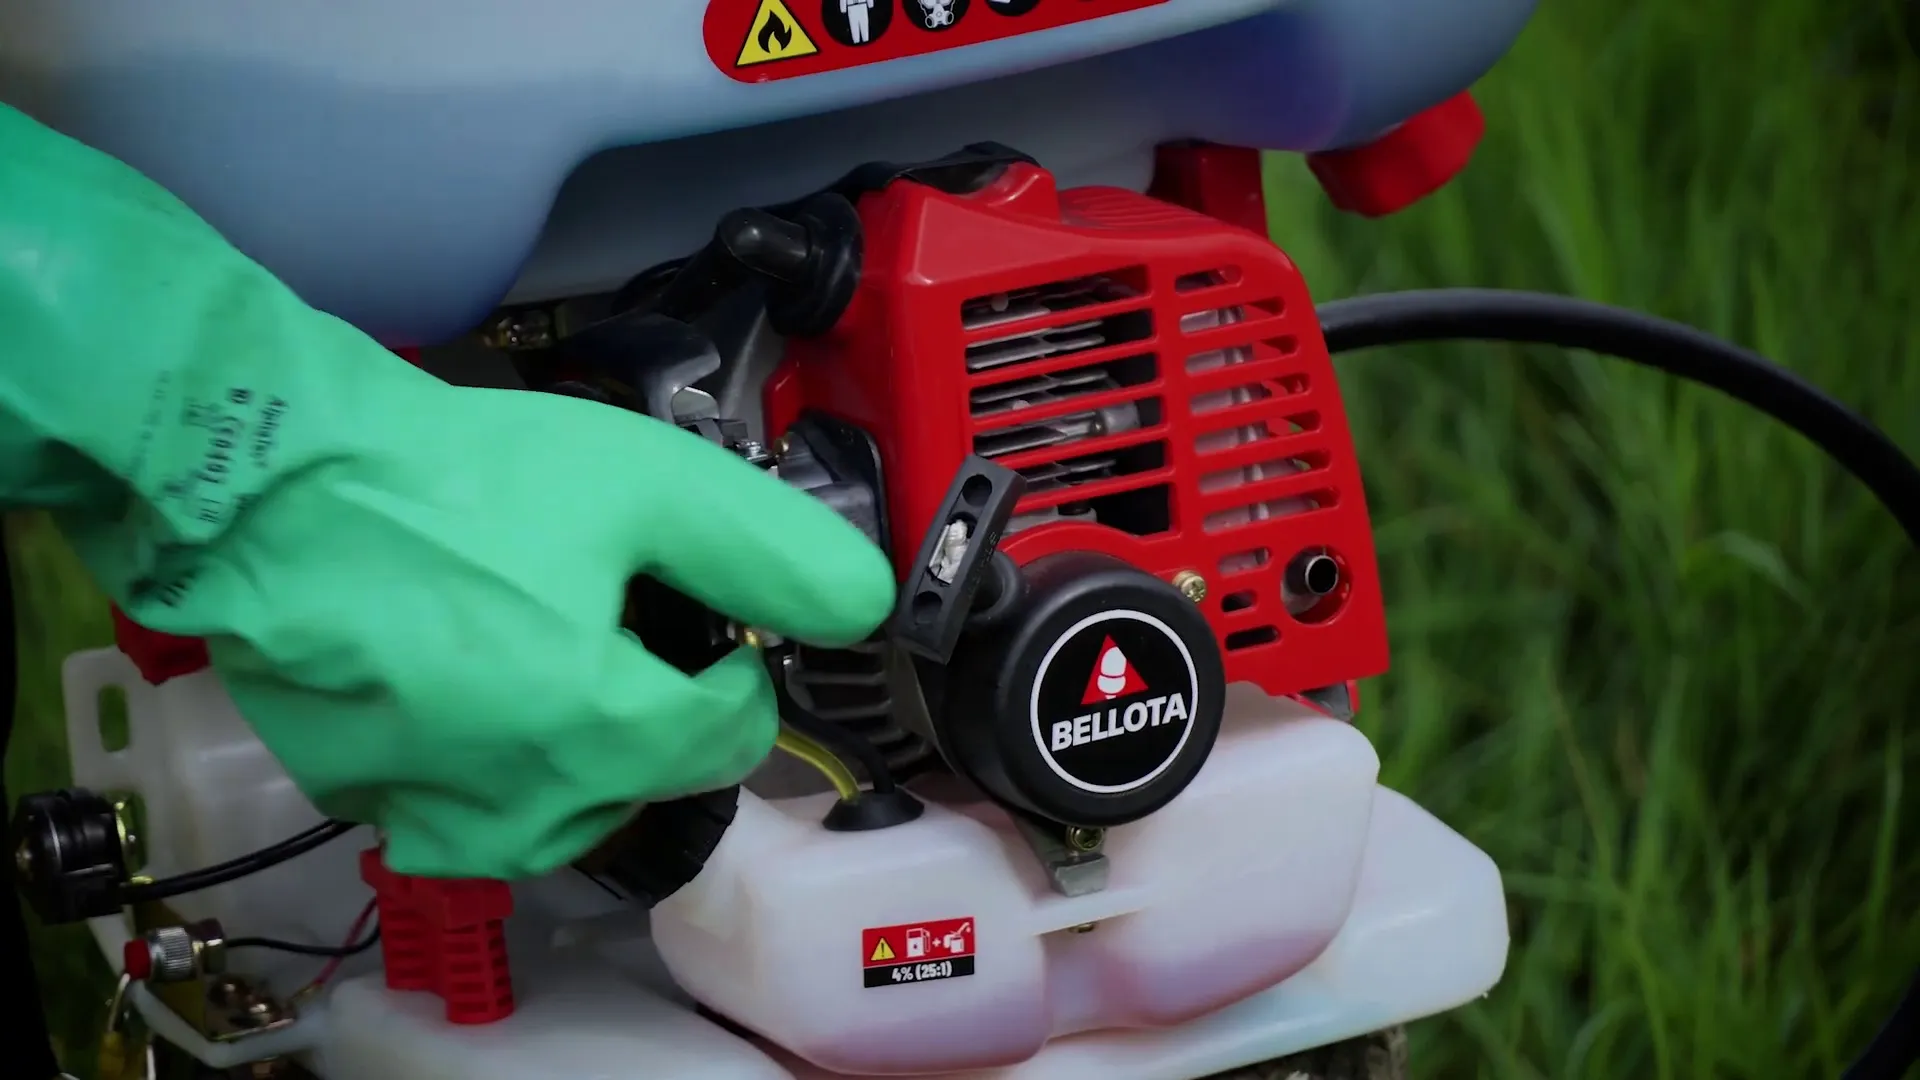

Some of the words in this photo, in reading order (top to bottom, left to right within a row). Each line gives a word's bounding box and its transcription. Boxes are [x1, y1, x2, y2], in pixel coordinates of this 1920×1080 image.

[1051, 692, 1188, 752] BELLOTA
[891, 967, 914, 981] 4%
[915, 960, 952, 980] (25:1)
